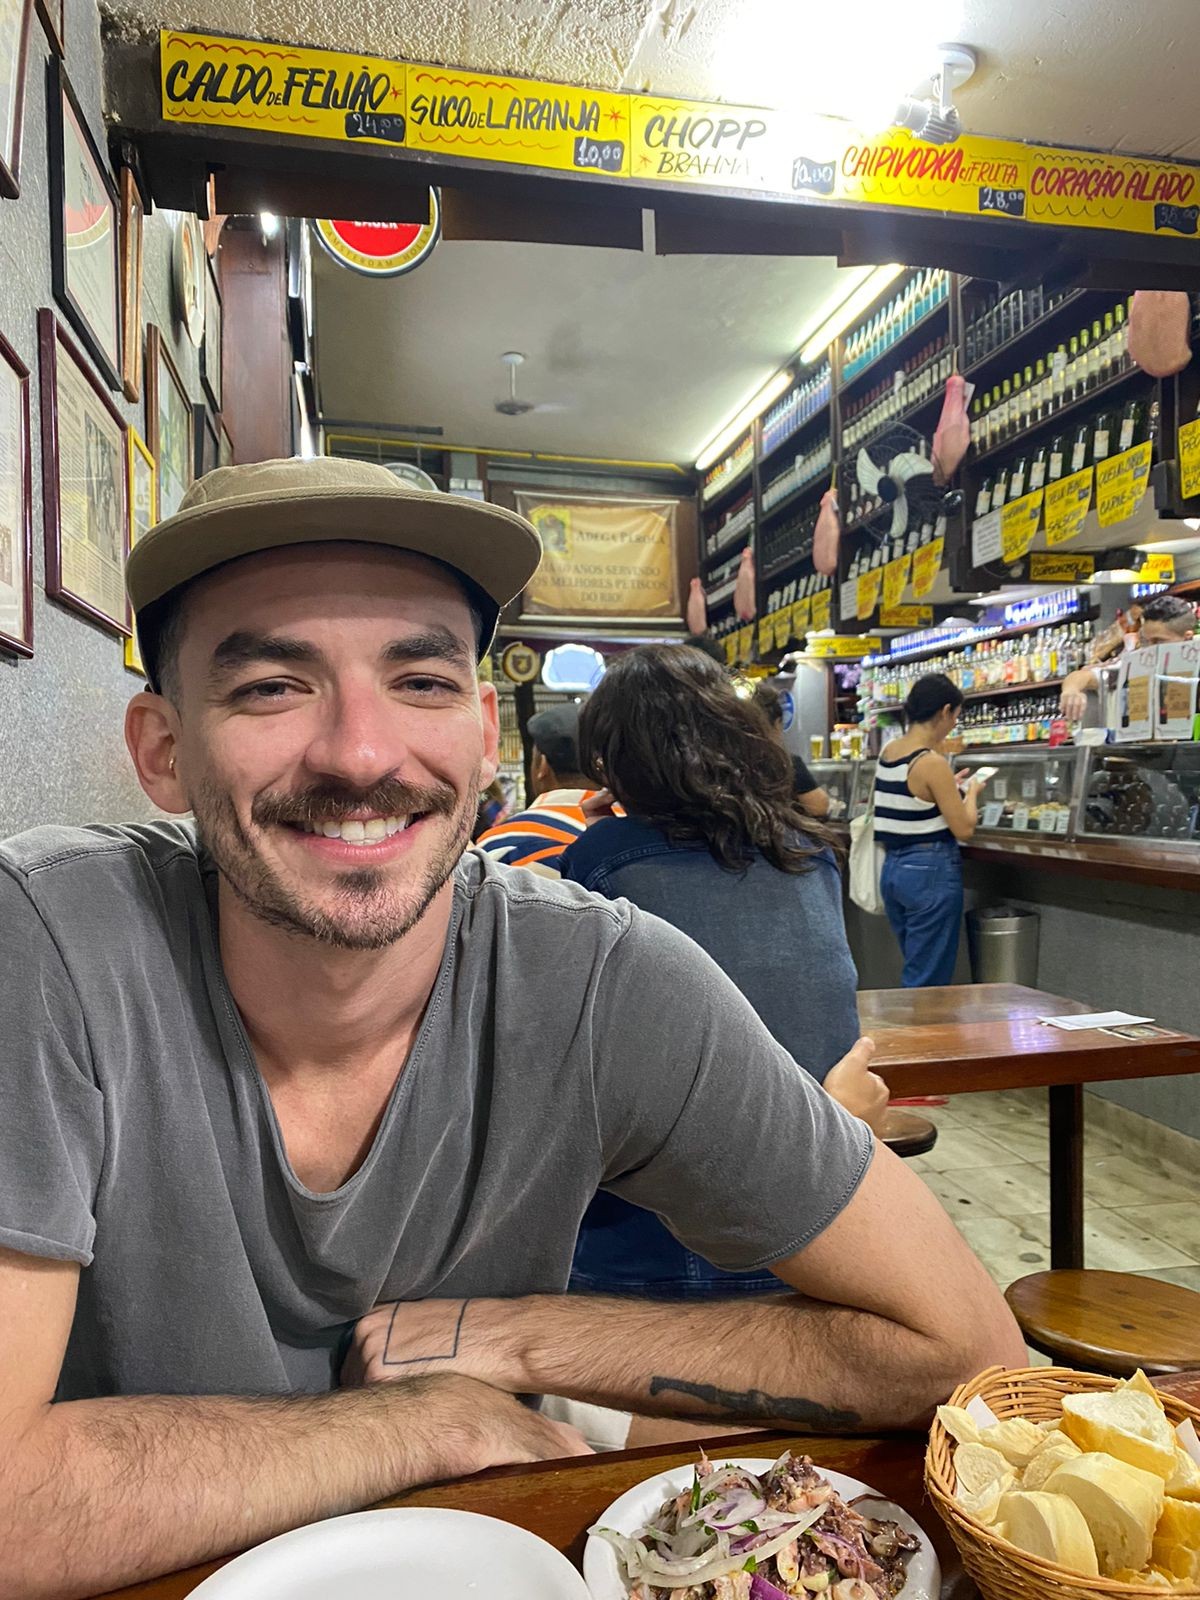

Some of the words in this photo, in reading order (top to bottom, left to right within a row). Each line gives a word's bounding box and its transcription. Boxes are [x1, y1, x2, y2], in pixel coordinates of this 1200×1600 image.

[165, 59, 272, 106] CALDO
[266, 91, 283, 107] DE
[282, 65, 391, 112] FEIJÃO
[409, 93, 472, 129] SUCO
[468, 111, 486, 129] DE
[485, 96, 601, 132] LARANJA
[643, 114, 767, 151] CHOPP
[656, 151, 750, 176] BRAHMA
[841, 144, 965, 184] CAIPIVODKA
[1030, 164, 1125, 202] CORAÇÃO
[1123, 169, 1196, 202] ALADO
[576, 530, 617, 543] ADEGA
